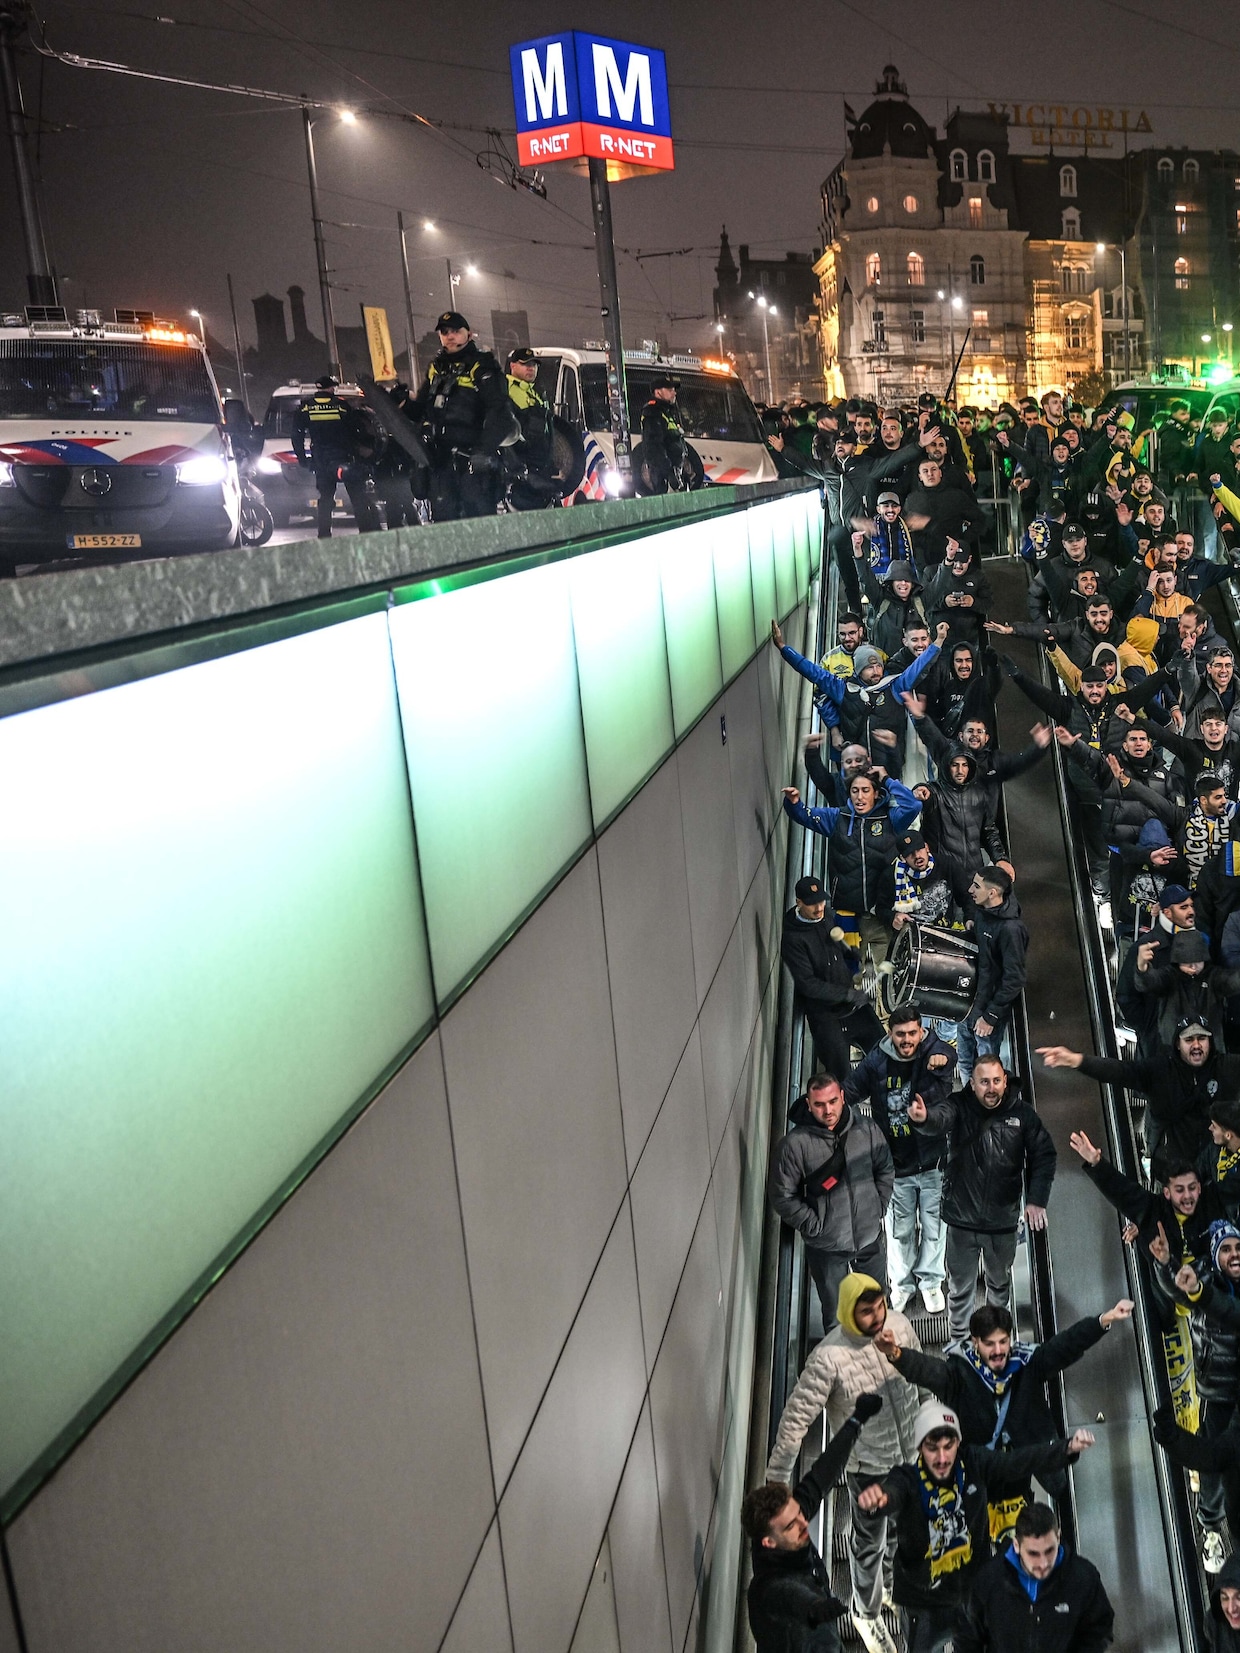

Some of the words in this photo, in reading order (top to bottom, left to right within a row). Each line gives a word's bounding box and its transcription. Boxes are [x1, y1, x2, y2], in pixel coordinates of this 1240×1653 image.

[521, 42, 568, 122] M
[592, 43, 654, 126] M
[987, 103, 1153, 133] VICTORIA
[1030, 129, 1113, 148] HOTEL
[79, 536, 135, 546] H-552-ZZ
